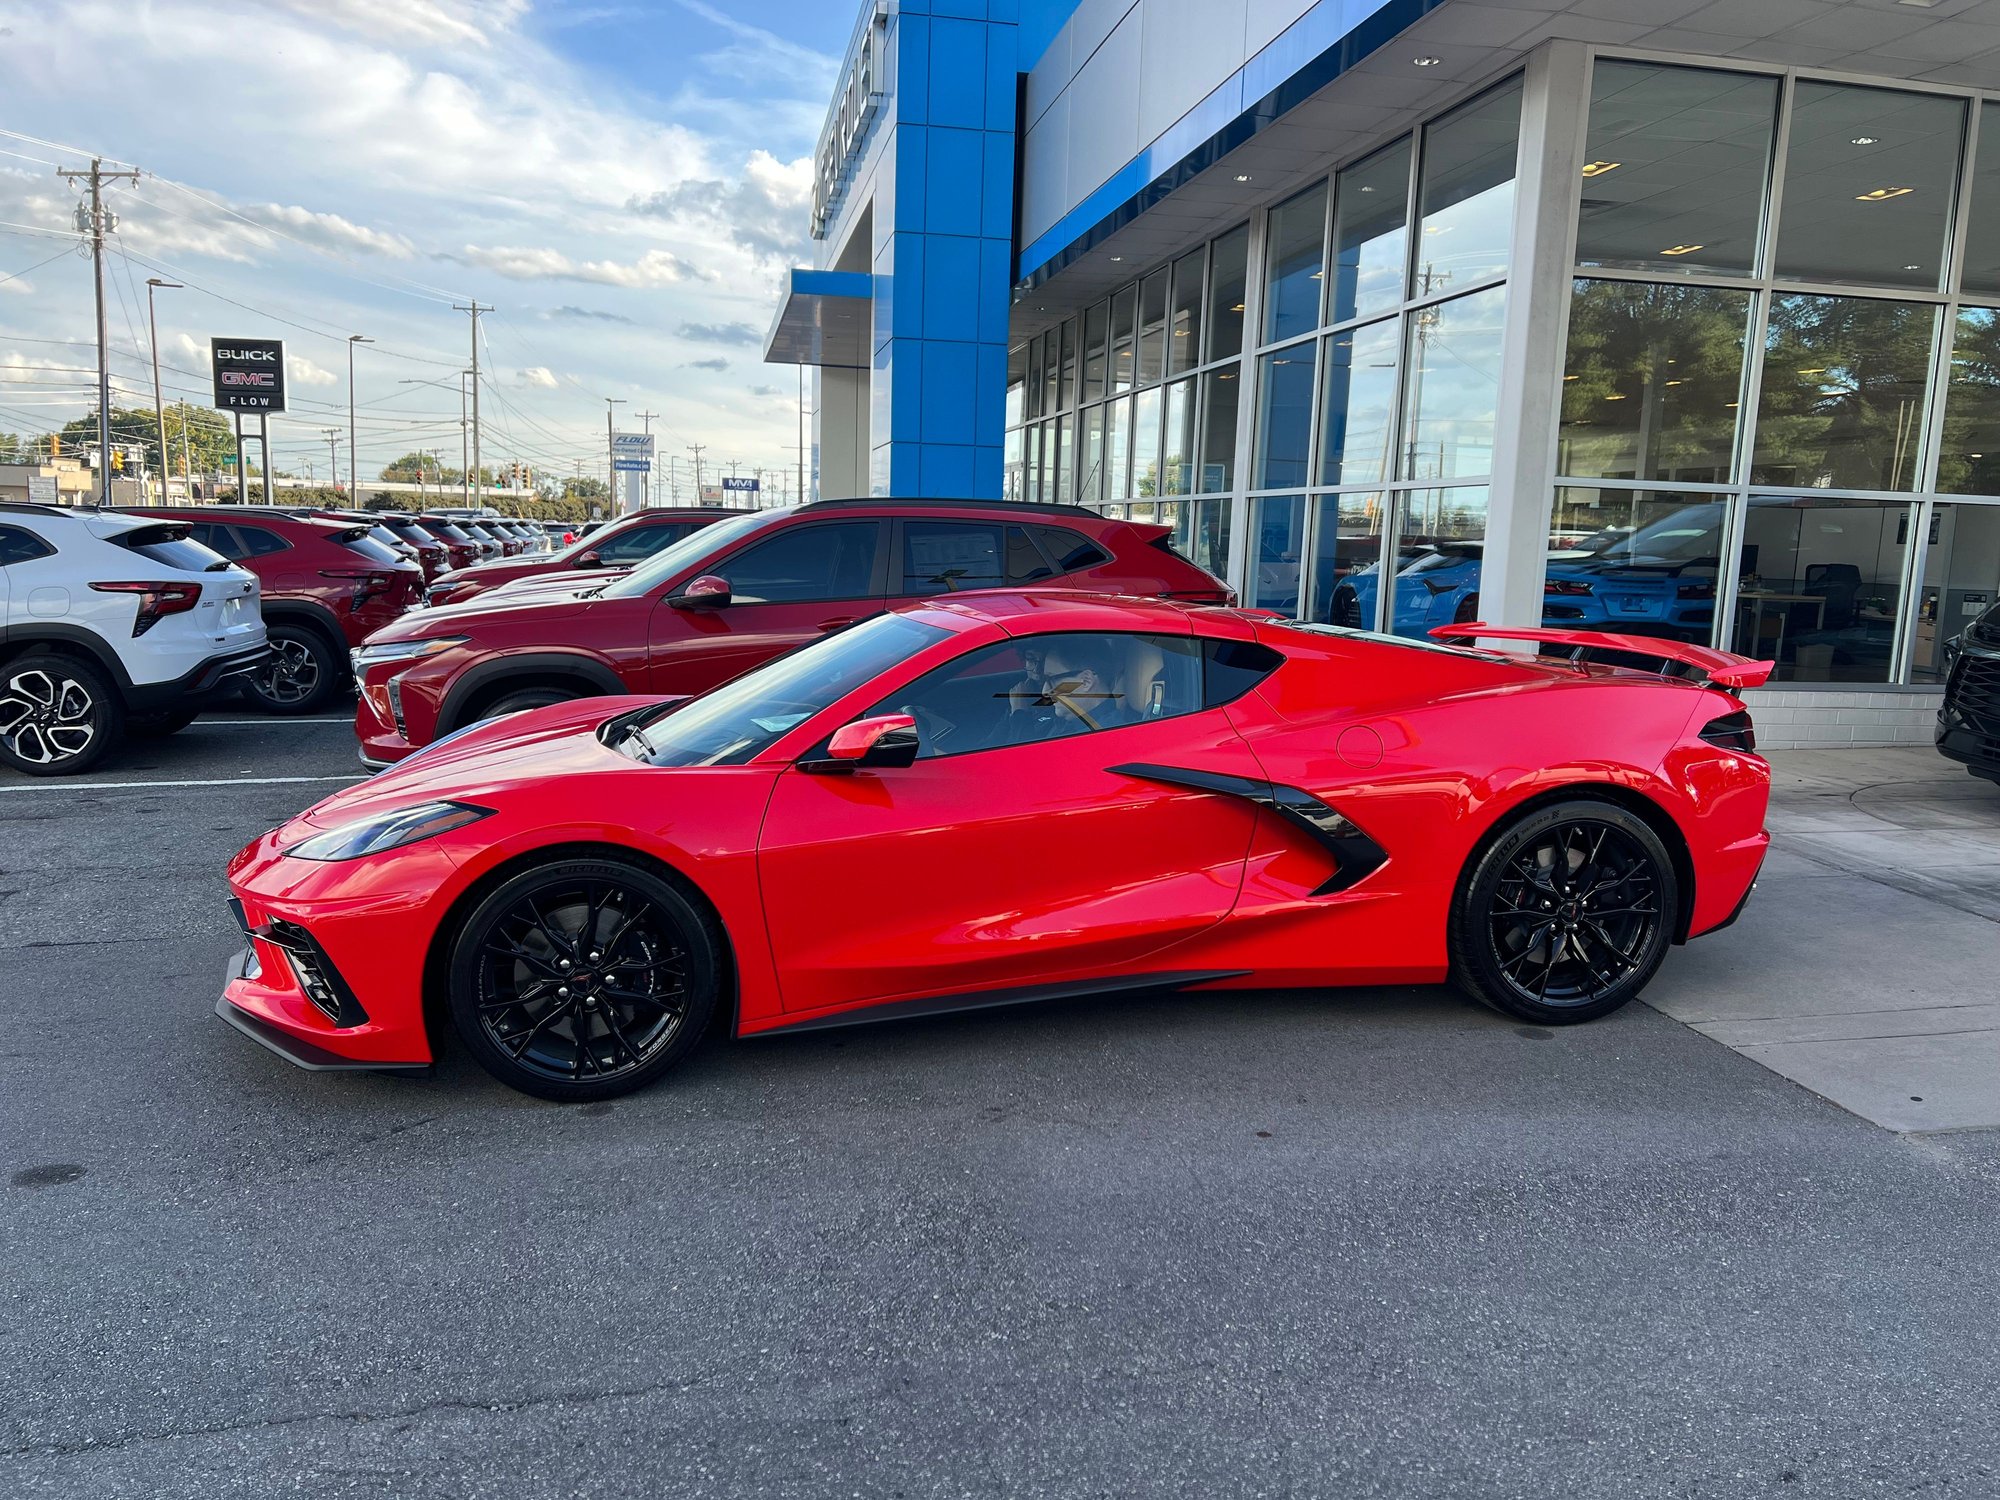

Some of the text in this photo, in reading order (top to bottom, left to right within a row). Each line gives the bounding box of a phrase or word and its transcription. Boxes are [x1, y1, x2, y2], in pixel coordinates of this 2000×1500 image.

[217, 349, 276, 361] BUICK
[221, 372, 275, 386] GMC
[230, 396, 269, 406] FLOW
[615, 436, 651, 444] FLOW
